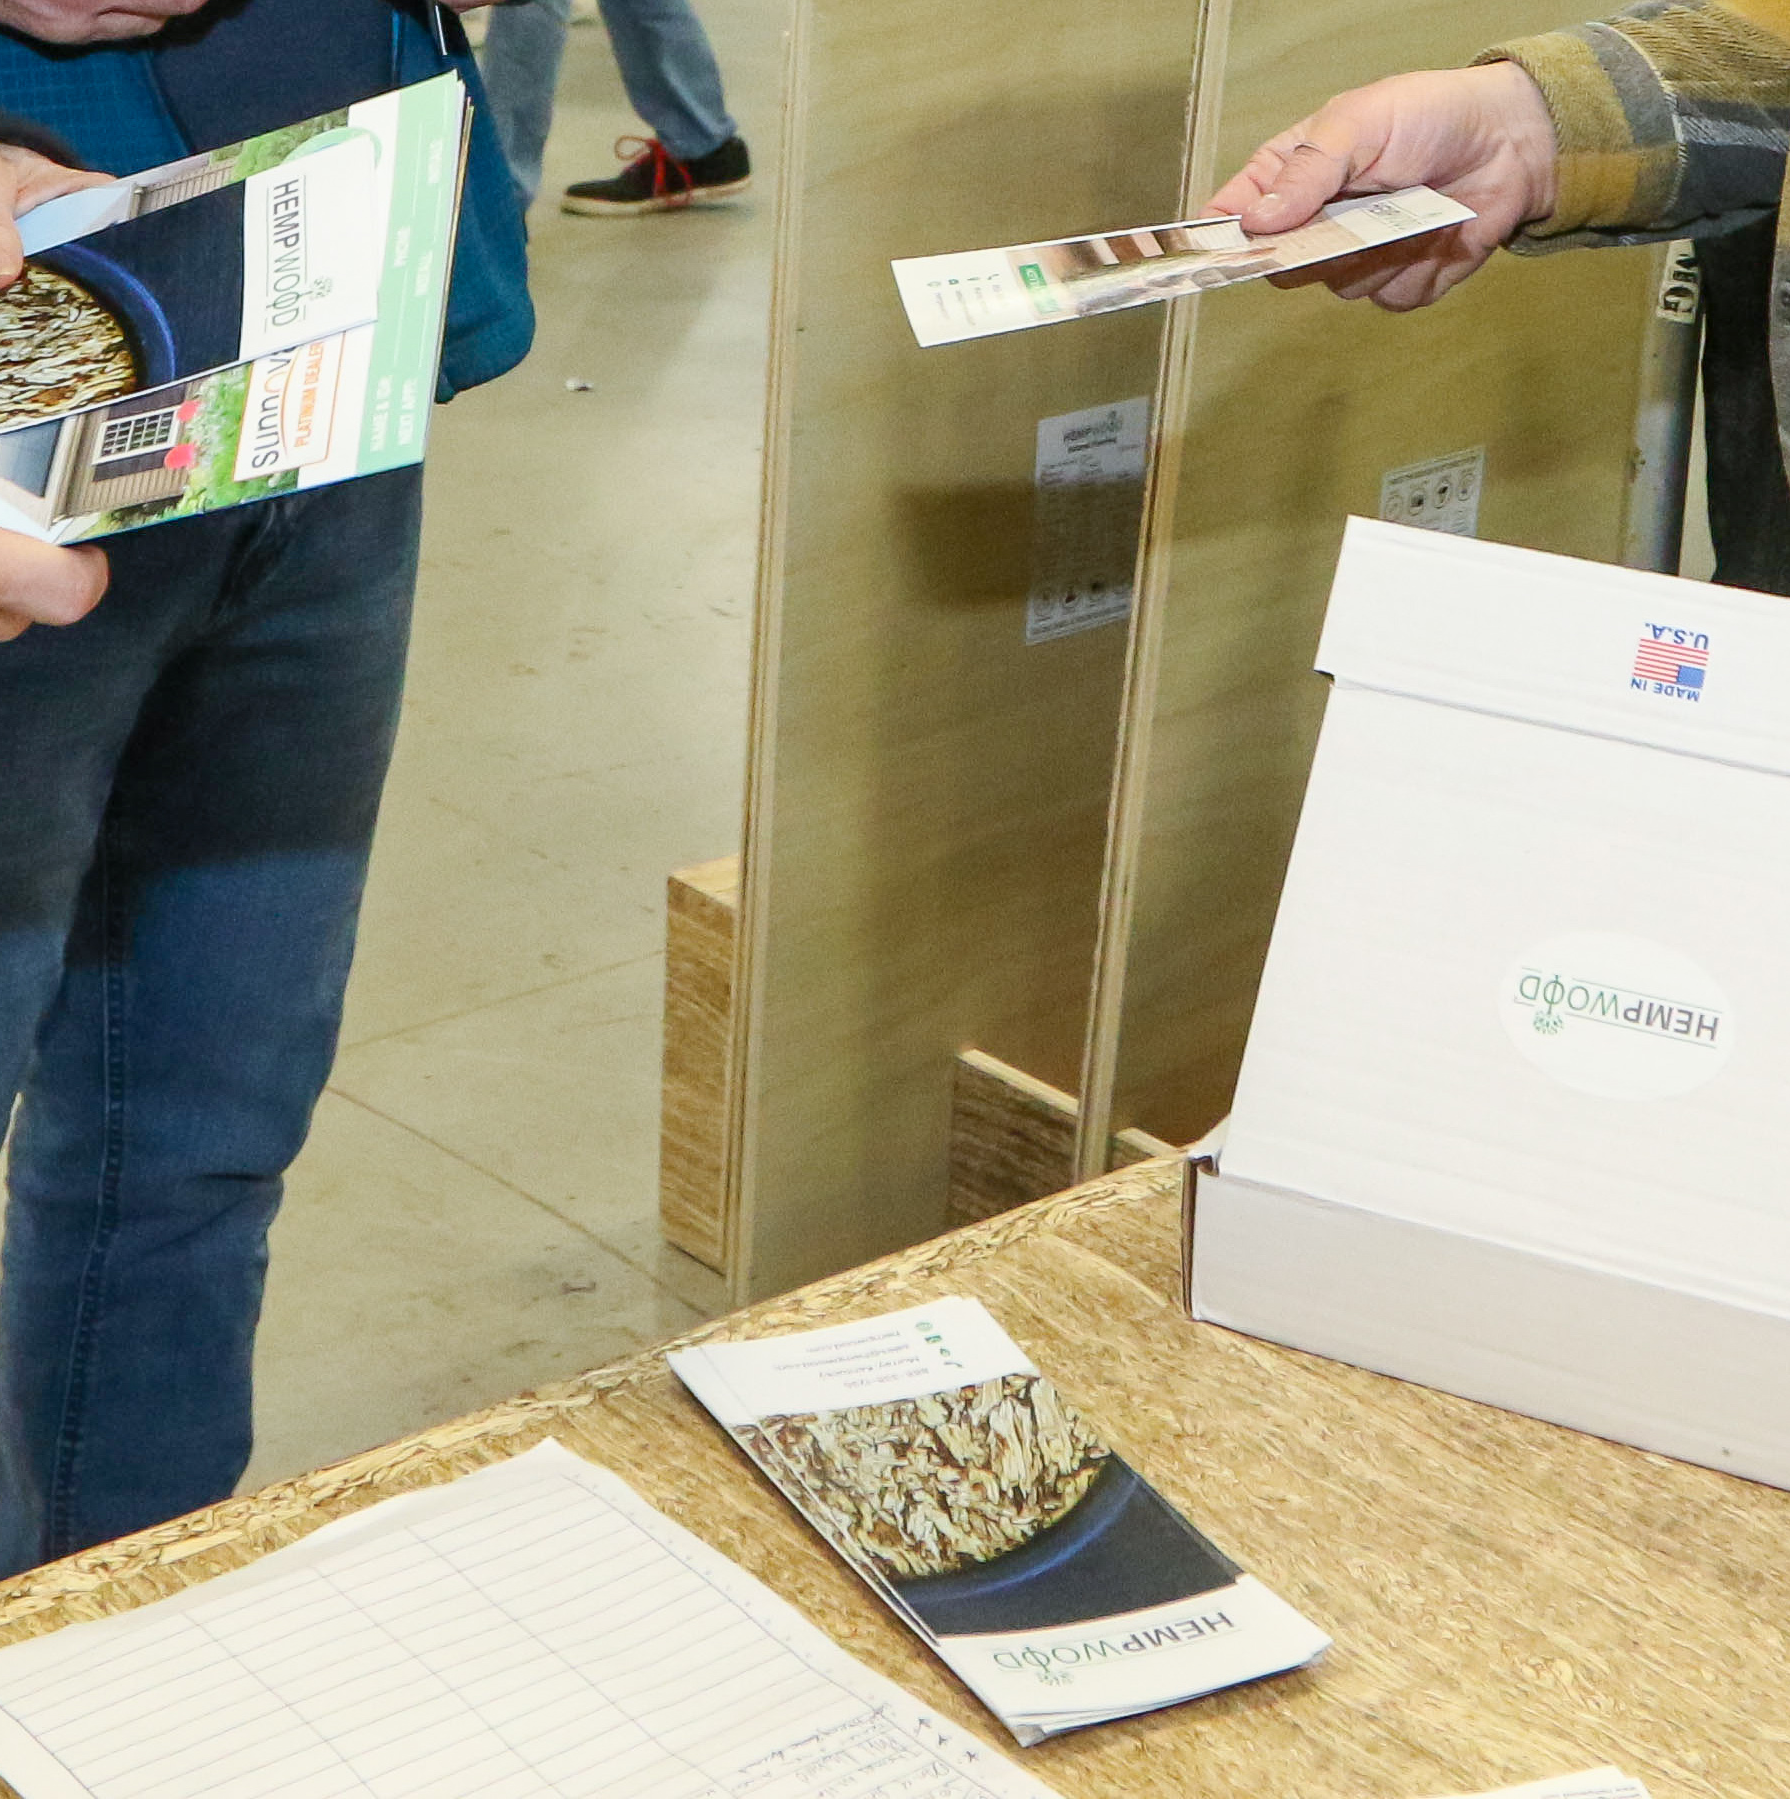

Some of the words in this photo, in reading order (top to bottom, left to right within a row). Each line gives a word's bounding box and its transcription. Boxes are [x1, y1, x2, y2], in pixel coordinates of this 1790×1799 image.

[271, 177, 301, 327] HEMPWOOD
[293, 385, 319, 448] PLATINUM
[1644, 622, 1710, 651] U.S.A.
[1630, 677, 1647, 692] IN
[1653, 681, 1700, 702] MADE
[1519, 974, 1719, 1041] HEMPWOOD
[993, 1611, 1235, 1670] HEMPWOOD
